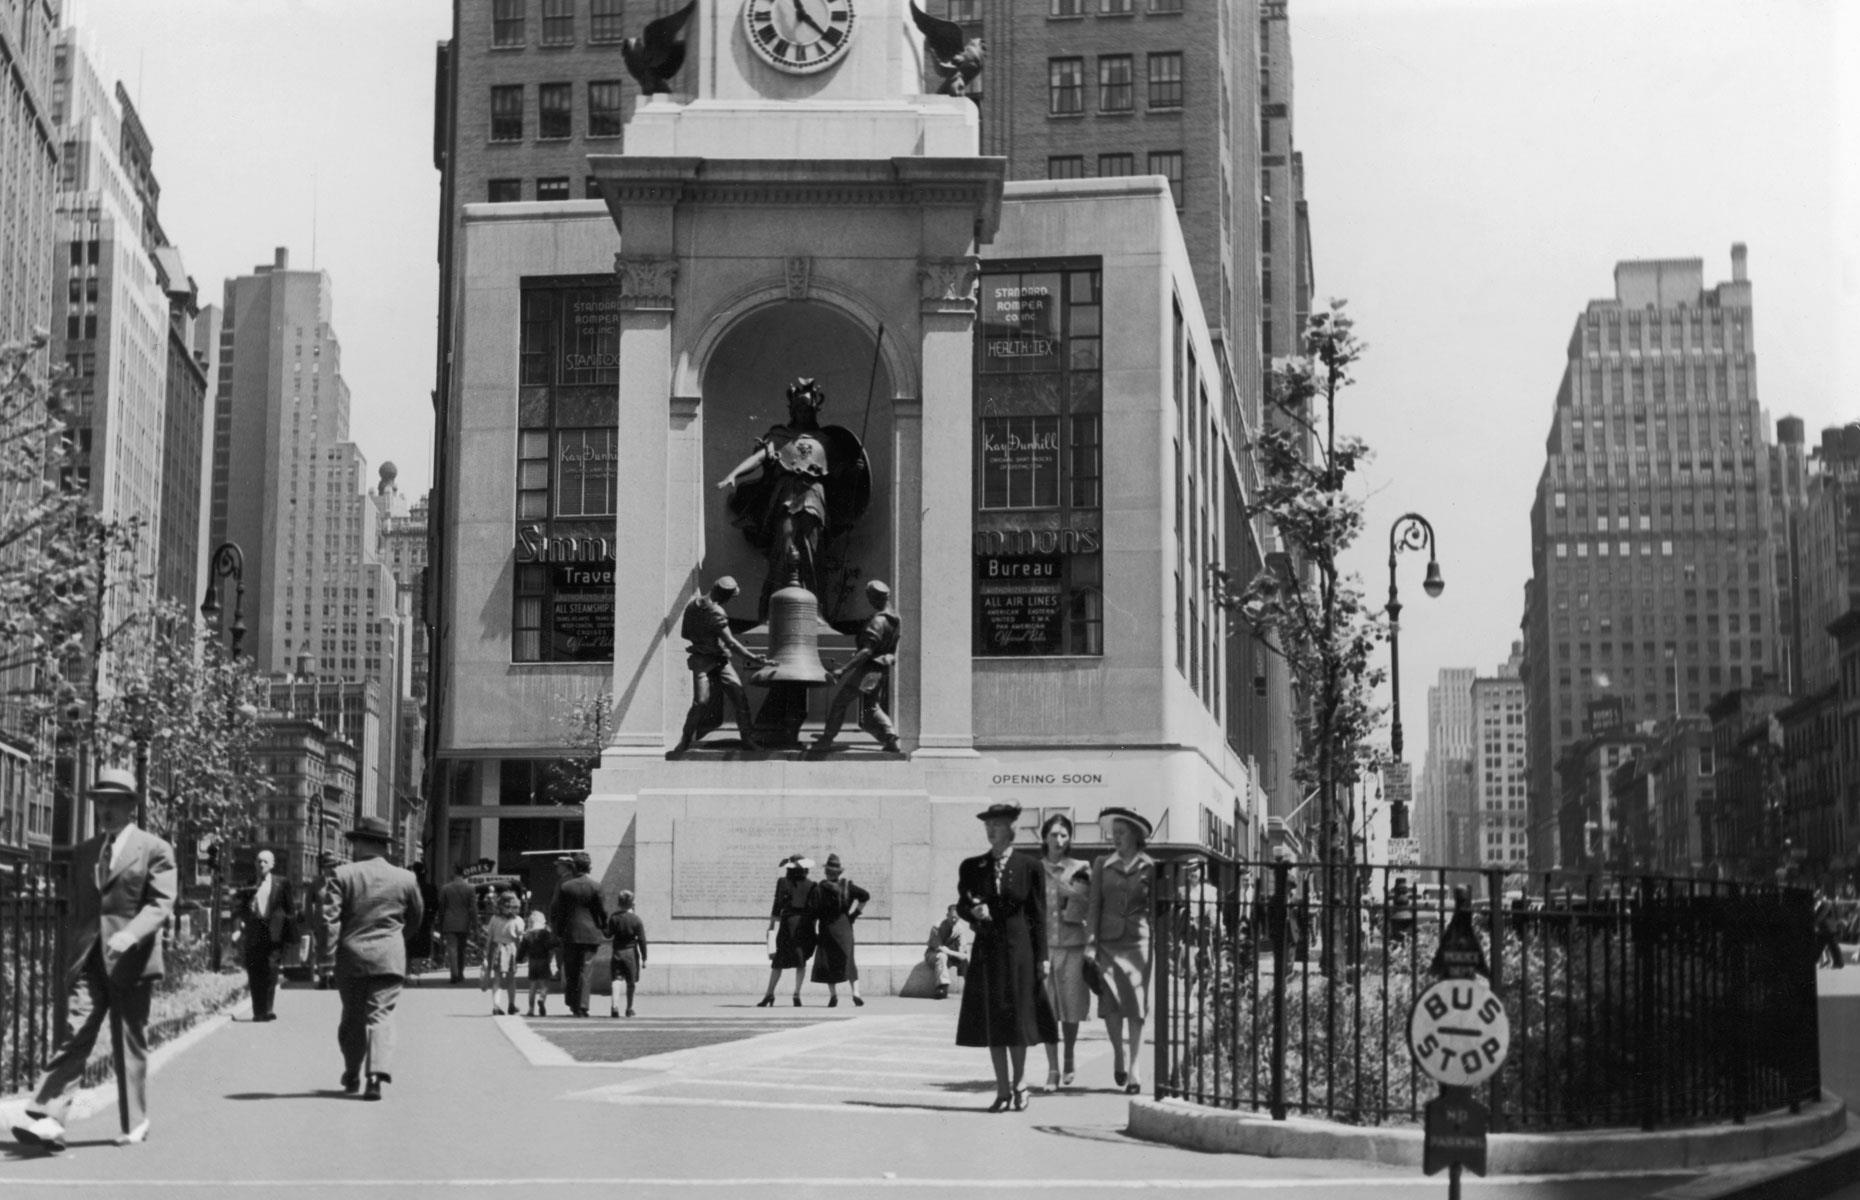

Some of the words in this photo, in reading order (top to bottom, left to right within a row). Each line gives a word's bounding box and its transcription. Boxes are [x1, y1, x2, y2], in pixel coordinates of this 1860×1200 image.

[995, 286, 1049, 298] STANDARD
[574, 301, 620, 312] STANDAR
[996, 300, 1044, 311] ROMPER
[984, 433, 1009, 457] Kay
[517, 524, 617, 562] Simm
[975, 527, 1100, 555] mmons
[989, 559, 1053, 577] Bureau
[984, 597, 1002, 608] ALL
[1006, 596, 1024, 607] AIR
[1027, 595, 1058, 607] LINES
[992, 774, 1056, 785] OPENING
[1061, 774, 1102, 784] SOON
[1424, 986, 1501, 1025] BUS
[1416, 1033, 1501, 1075] STOP
